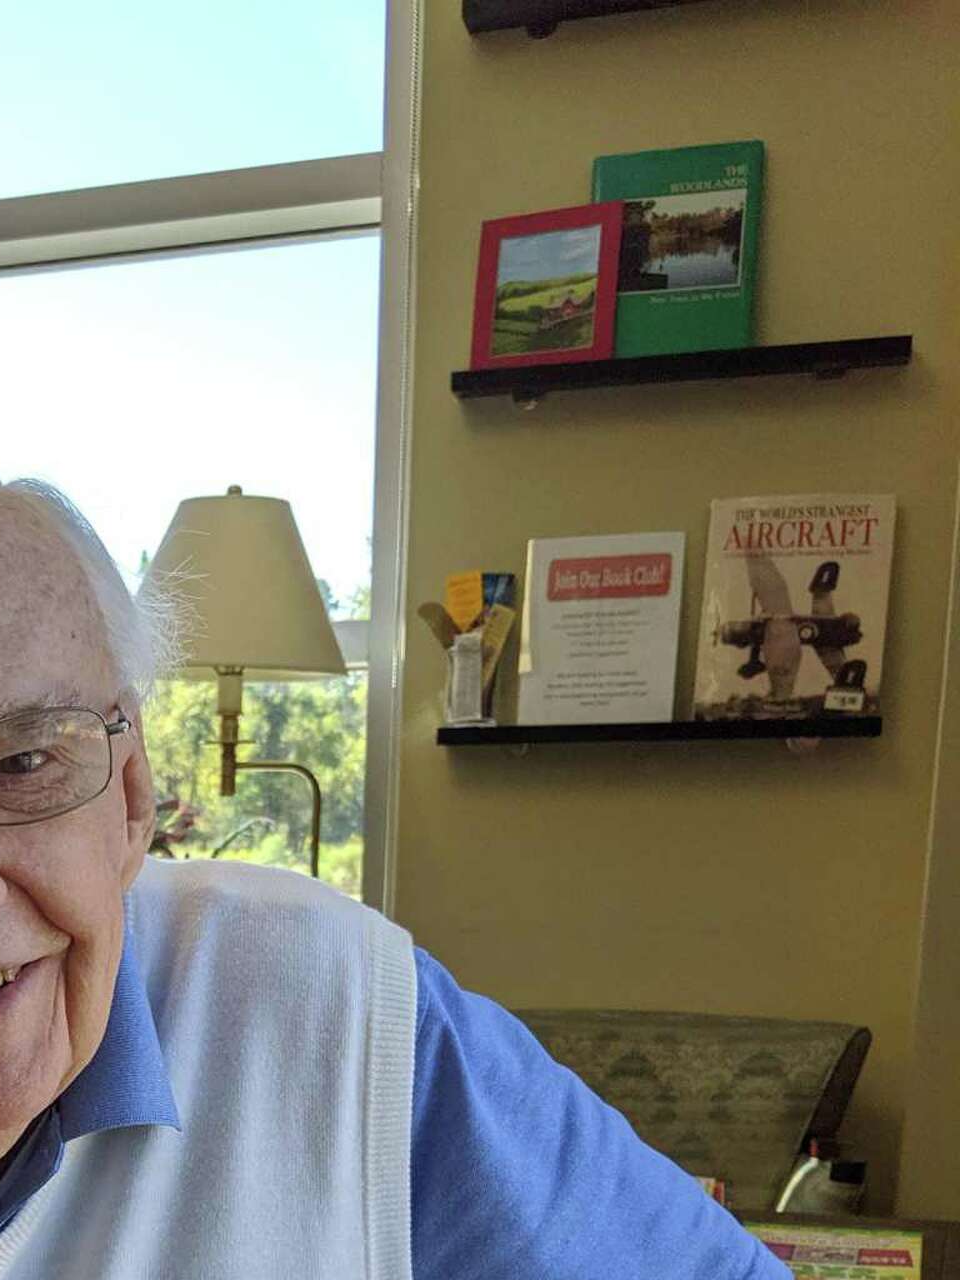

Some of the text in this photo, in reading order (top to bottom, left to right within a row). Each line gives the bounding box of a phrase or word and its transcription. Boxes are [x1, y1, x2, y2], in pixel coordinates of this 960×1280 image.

[735, 508, 755, 520] THE
[807, 504, 870, 518] STRANGEST
[724, 518, 879, 550] AIRCRAFT
[579, 569, 601, 590] Our
[602, 566, 632, 588] Book
